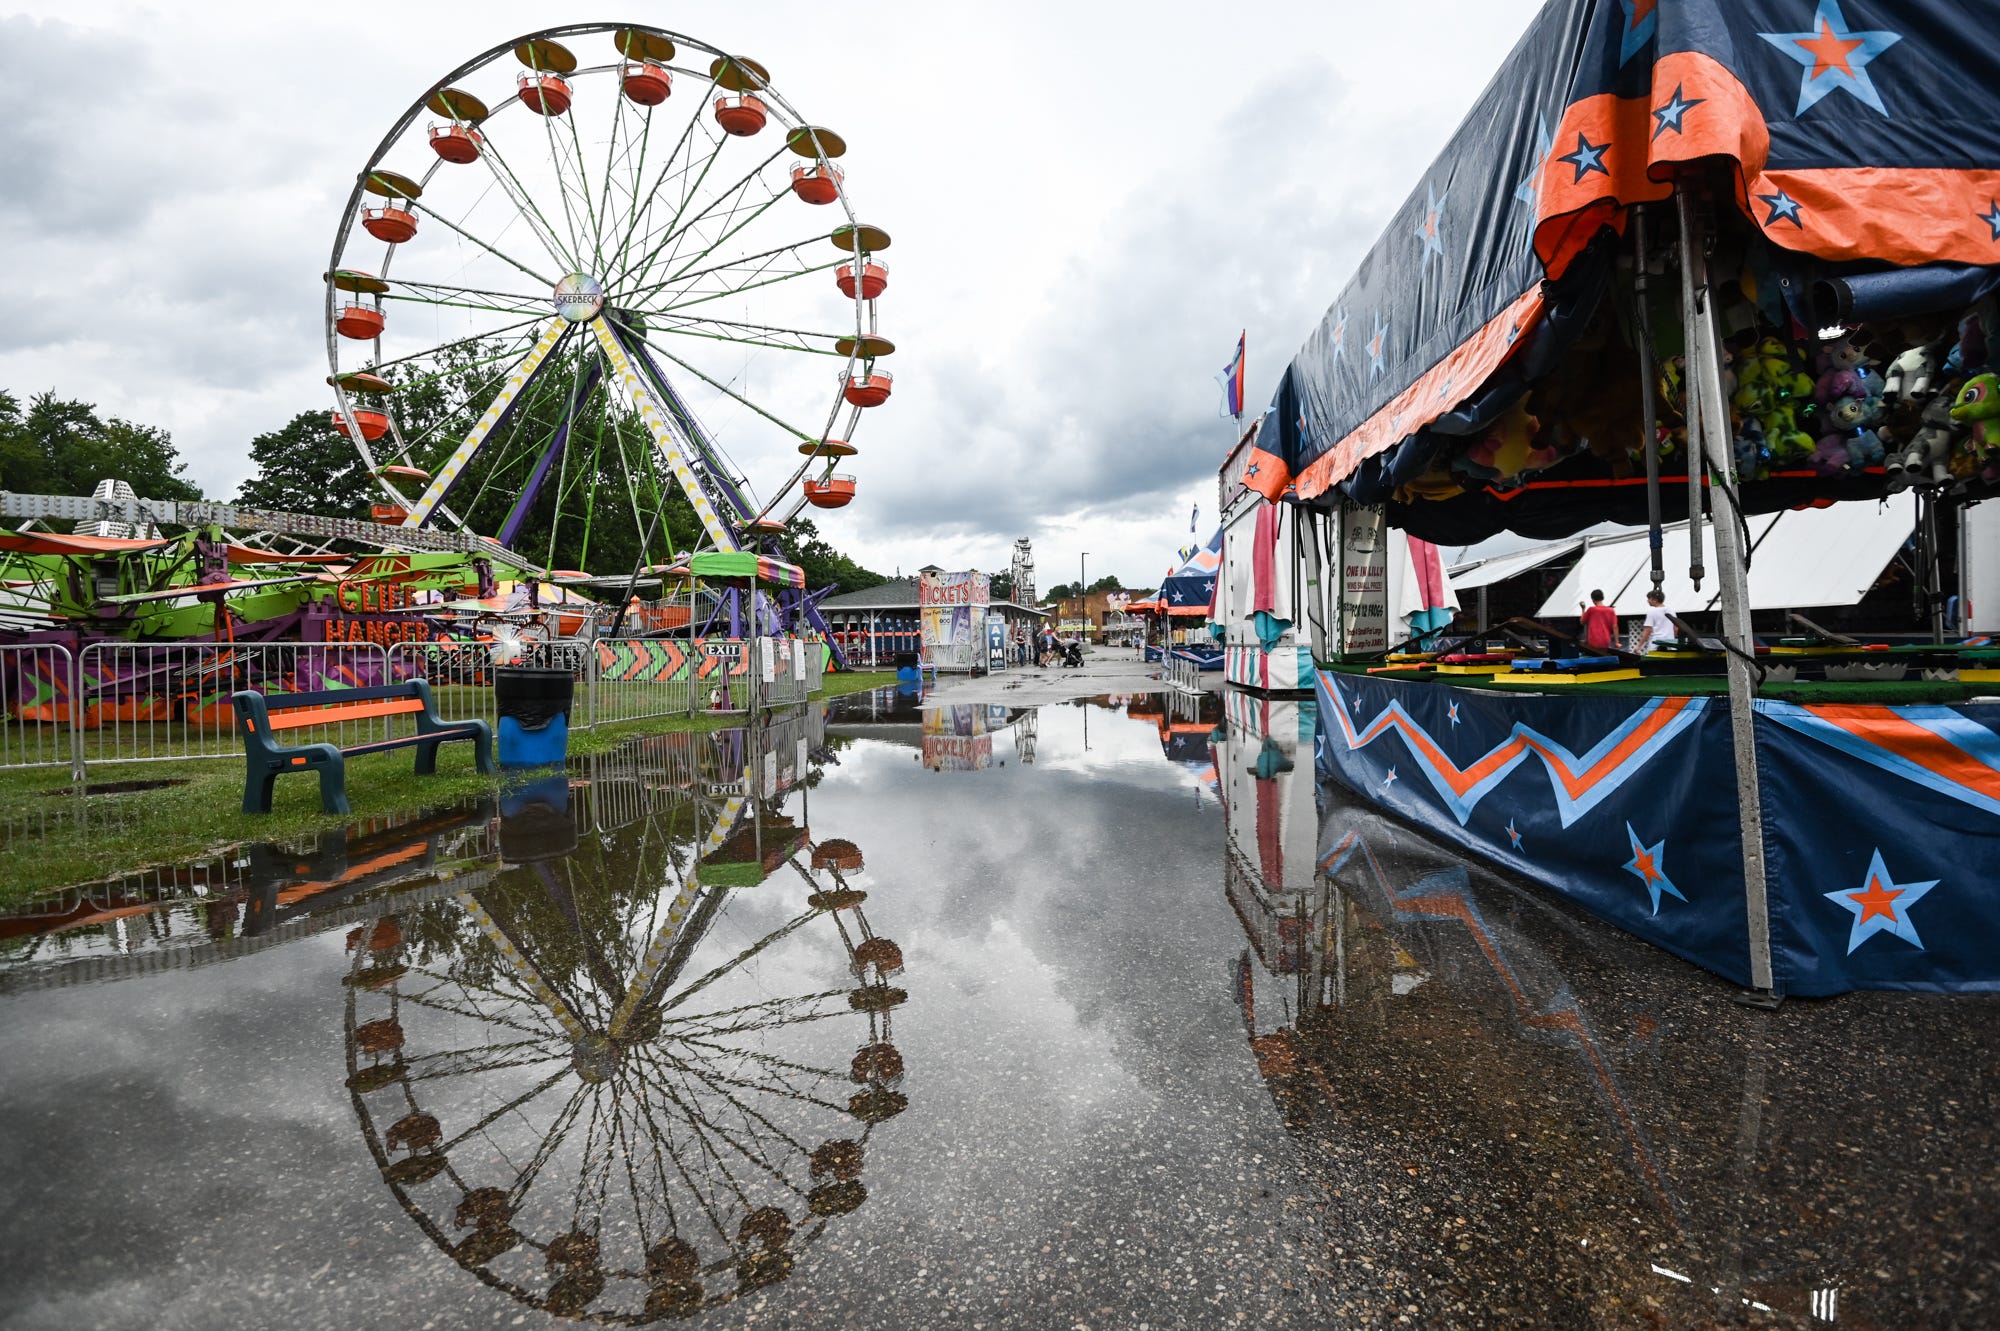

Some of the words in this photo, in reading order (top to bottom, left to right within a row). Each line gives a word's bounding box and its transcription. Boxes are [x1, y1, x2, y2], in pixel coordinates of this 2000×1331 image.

[557, 296, 599, 306] SKERBECK
[1346, 565, 1358, 577] ONE
[1360, 565, 1367, 577] IN
[1368, 565, 1384, 577] LILLY
[338, 581, 418, 613] CLIFF
[921, 581, 969, 603] TICKETS
[325, 620, 430, 651] HANGER
[991, 625, 1003, 659] ATM
[708, 645, 738, 655] EXIT
